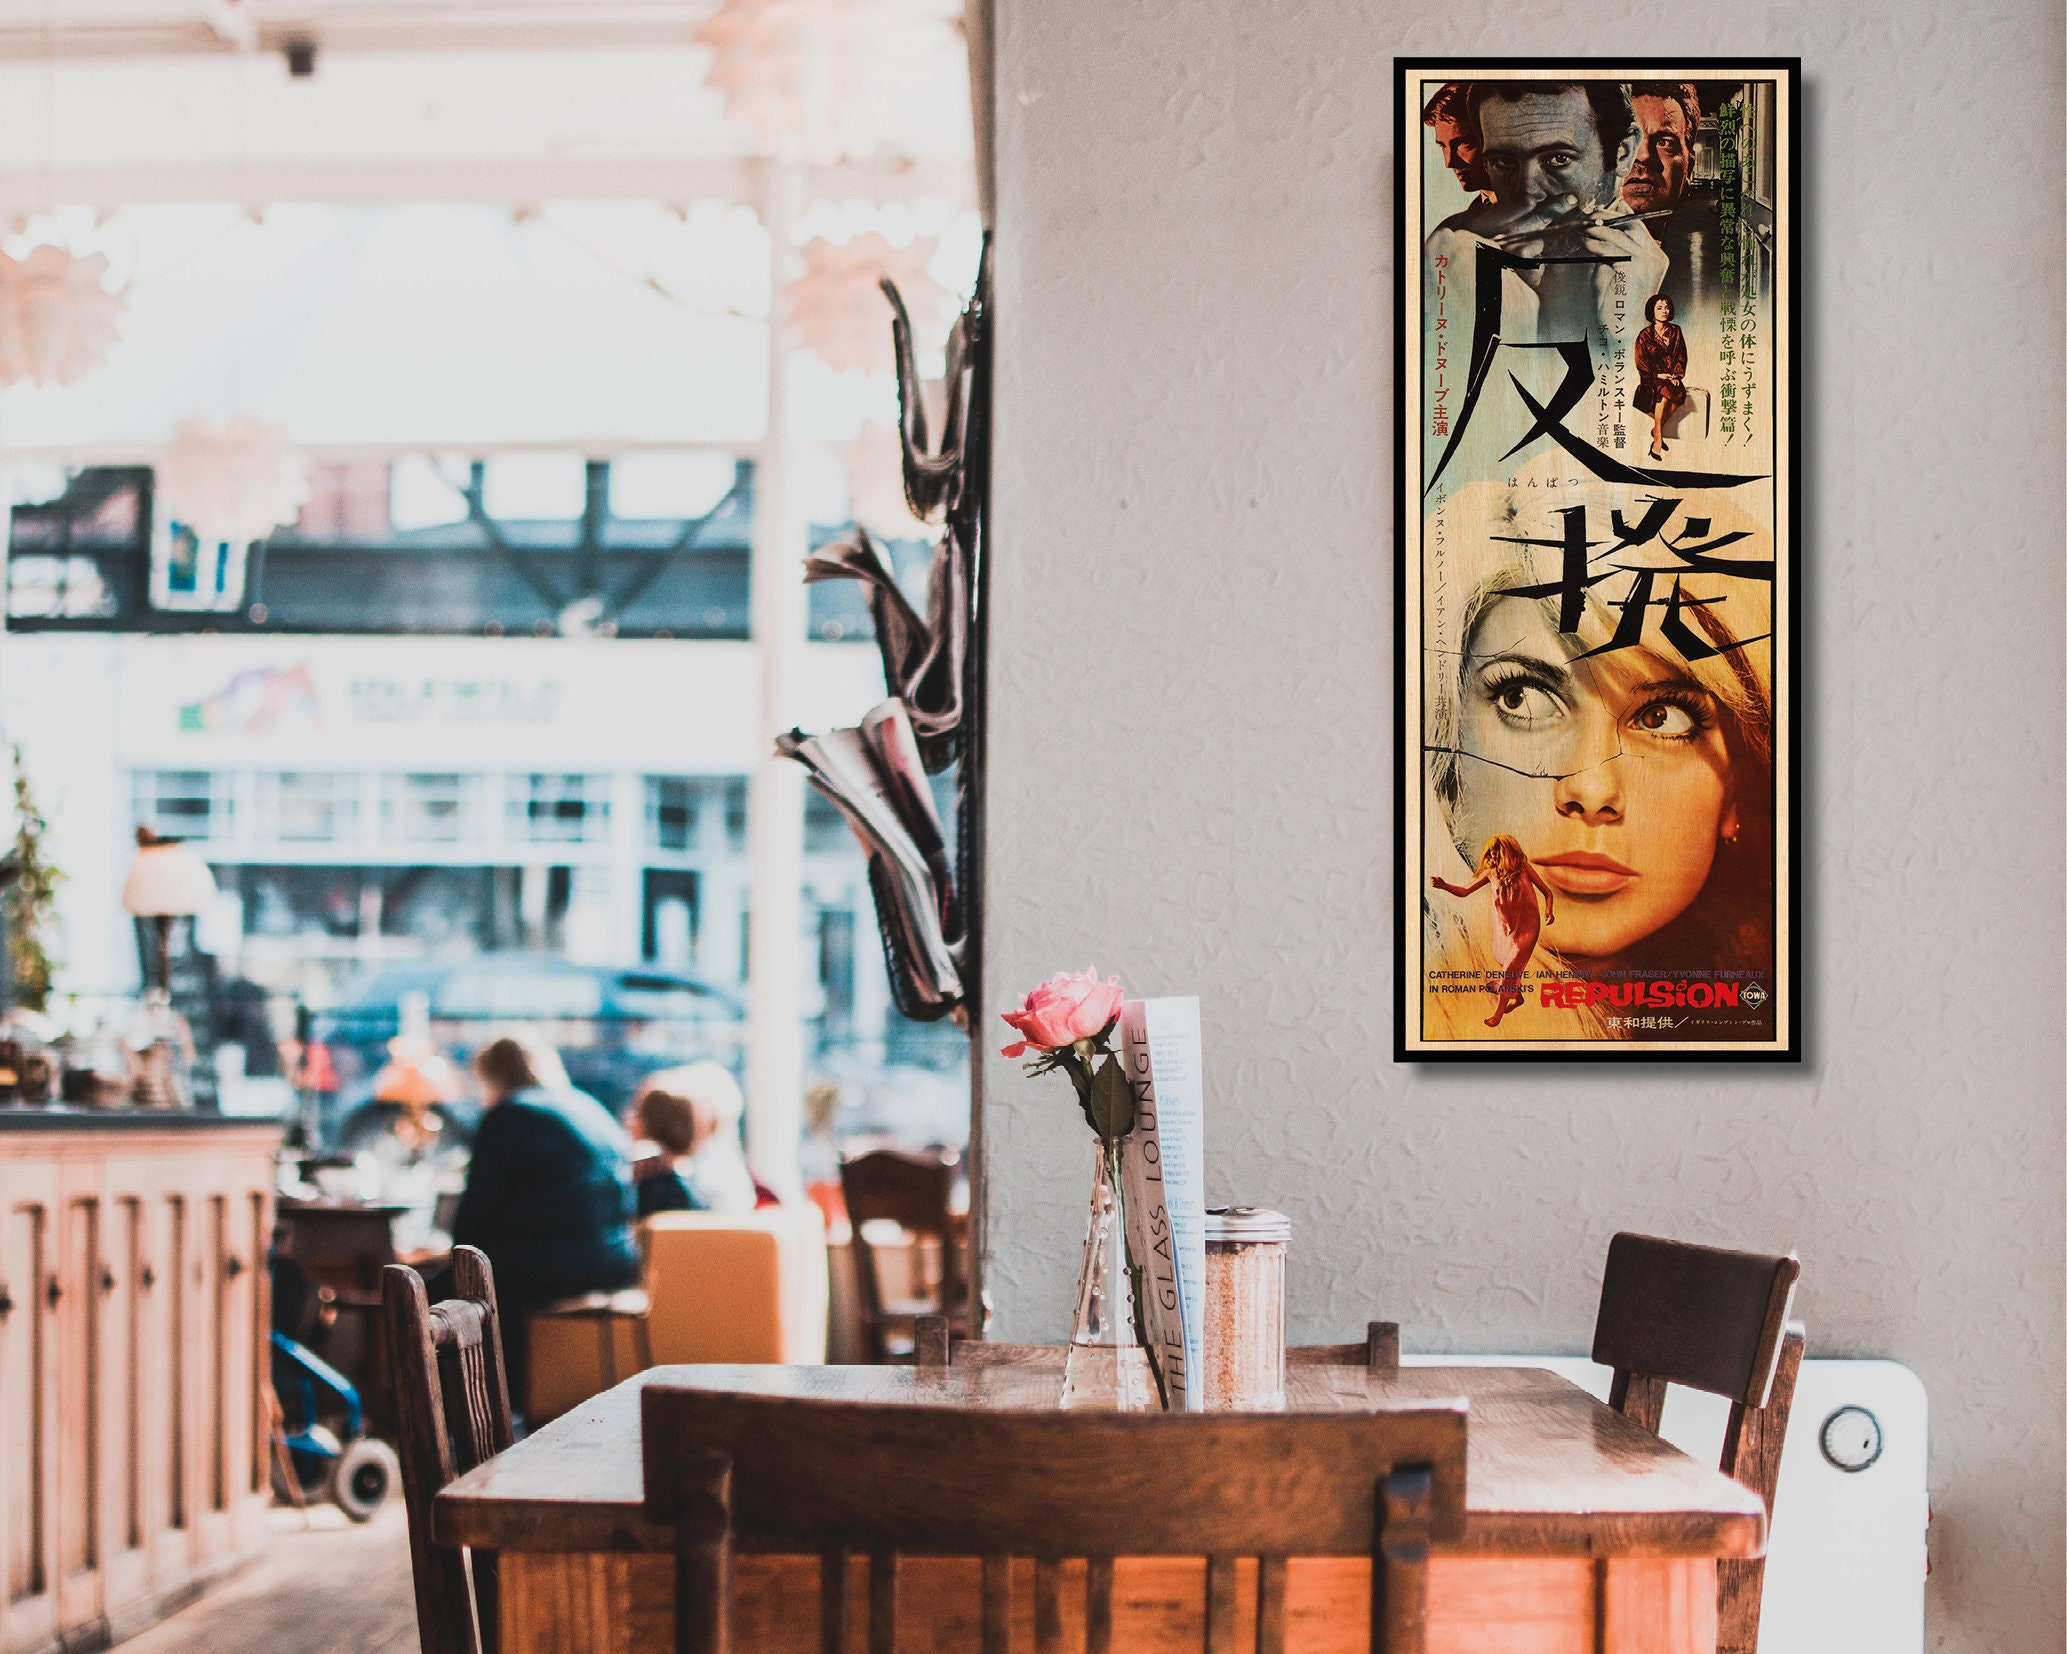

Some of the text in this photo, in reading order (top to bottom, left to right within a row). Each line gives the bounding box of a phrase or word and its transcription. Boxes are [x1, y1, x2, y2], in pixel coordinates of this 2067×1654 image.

[1432, 254, 1450, 437] カトリーヌ・ドヌーブ主演
[1428, 970, 1481, 979] CATHERINE
[1536, 970, 1555, 979] IAN
[1713, 970, 1764, 979] FURNEAUX
[1429, 984, 1439, 993] IN
[1441, 984, 1476, 993] ROMAN
[1132, 1029, 1161, 1181] LOUNGE
[1149, 1204, 1176, 1310] GLASS
[1164, 1329, 1186, 1394] THE
